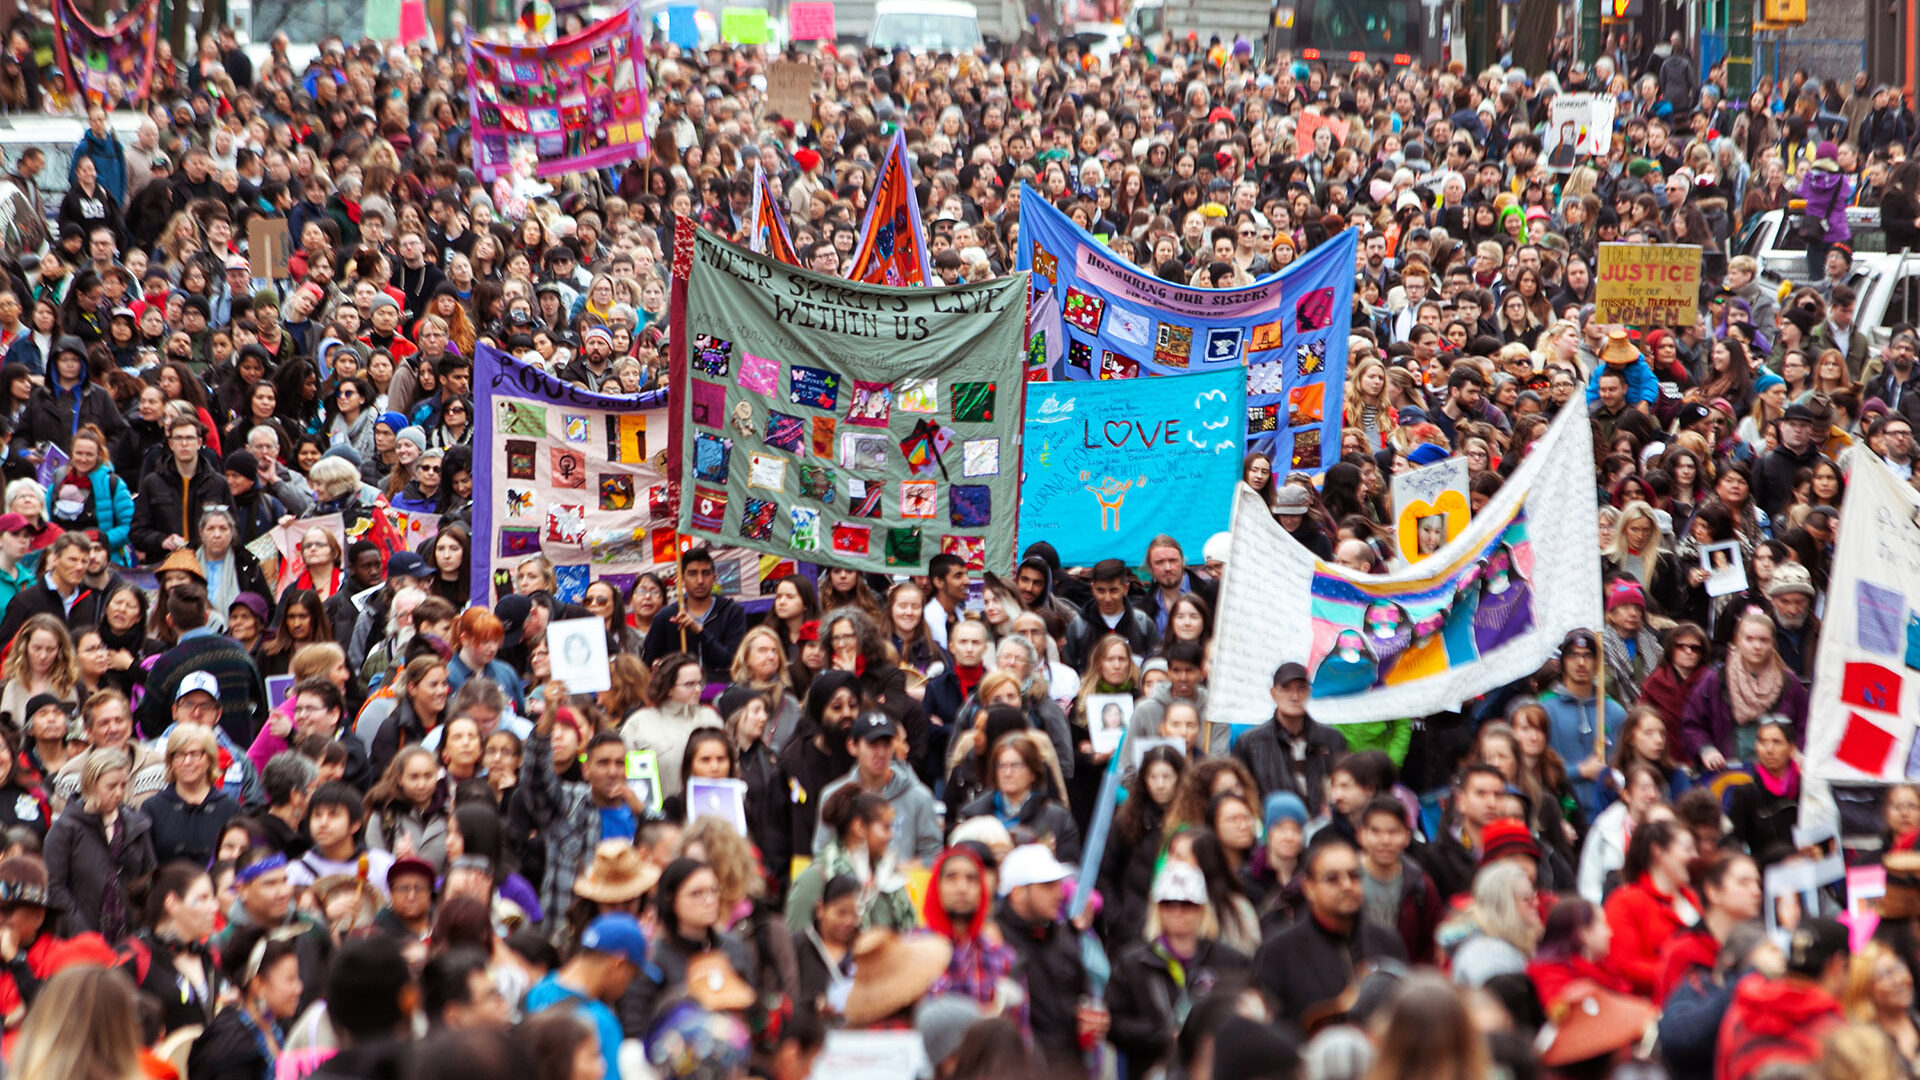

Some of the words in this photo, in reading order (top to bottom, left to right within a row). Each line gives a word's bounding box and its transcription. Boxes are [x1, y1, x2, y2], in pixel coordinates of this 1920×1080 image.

[698, 236, 773, 289] THEIR
[788, 274, 909, 313] SPIRITS
[933, 287, 1006, 313] LIVE
[1087, 253, 1166, 299] HONOURING
[1174, 292, 1203, 305] OUR
[1211, 288, 1269, 306] SISTERS
[1601, 264, 1697, 282] JUSTICE
[1628, 283, 1641, 296] for
[1645, 288, 1664, 296] our
[1601, 297, 1636, 309] missing
[1648, 296, 1692, 307] murdered
[773, 294, 878, 338] WITHIN
[895, 316, 930, 341] US
[1607, 306, 1680, 326] WOMEN
